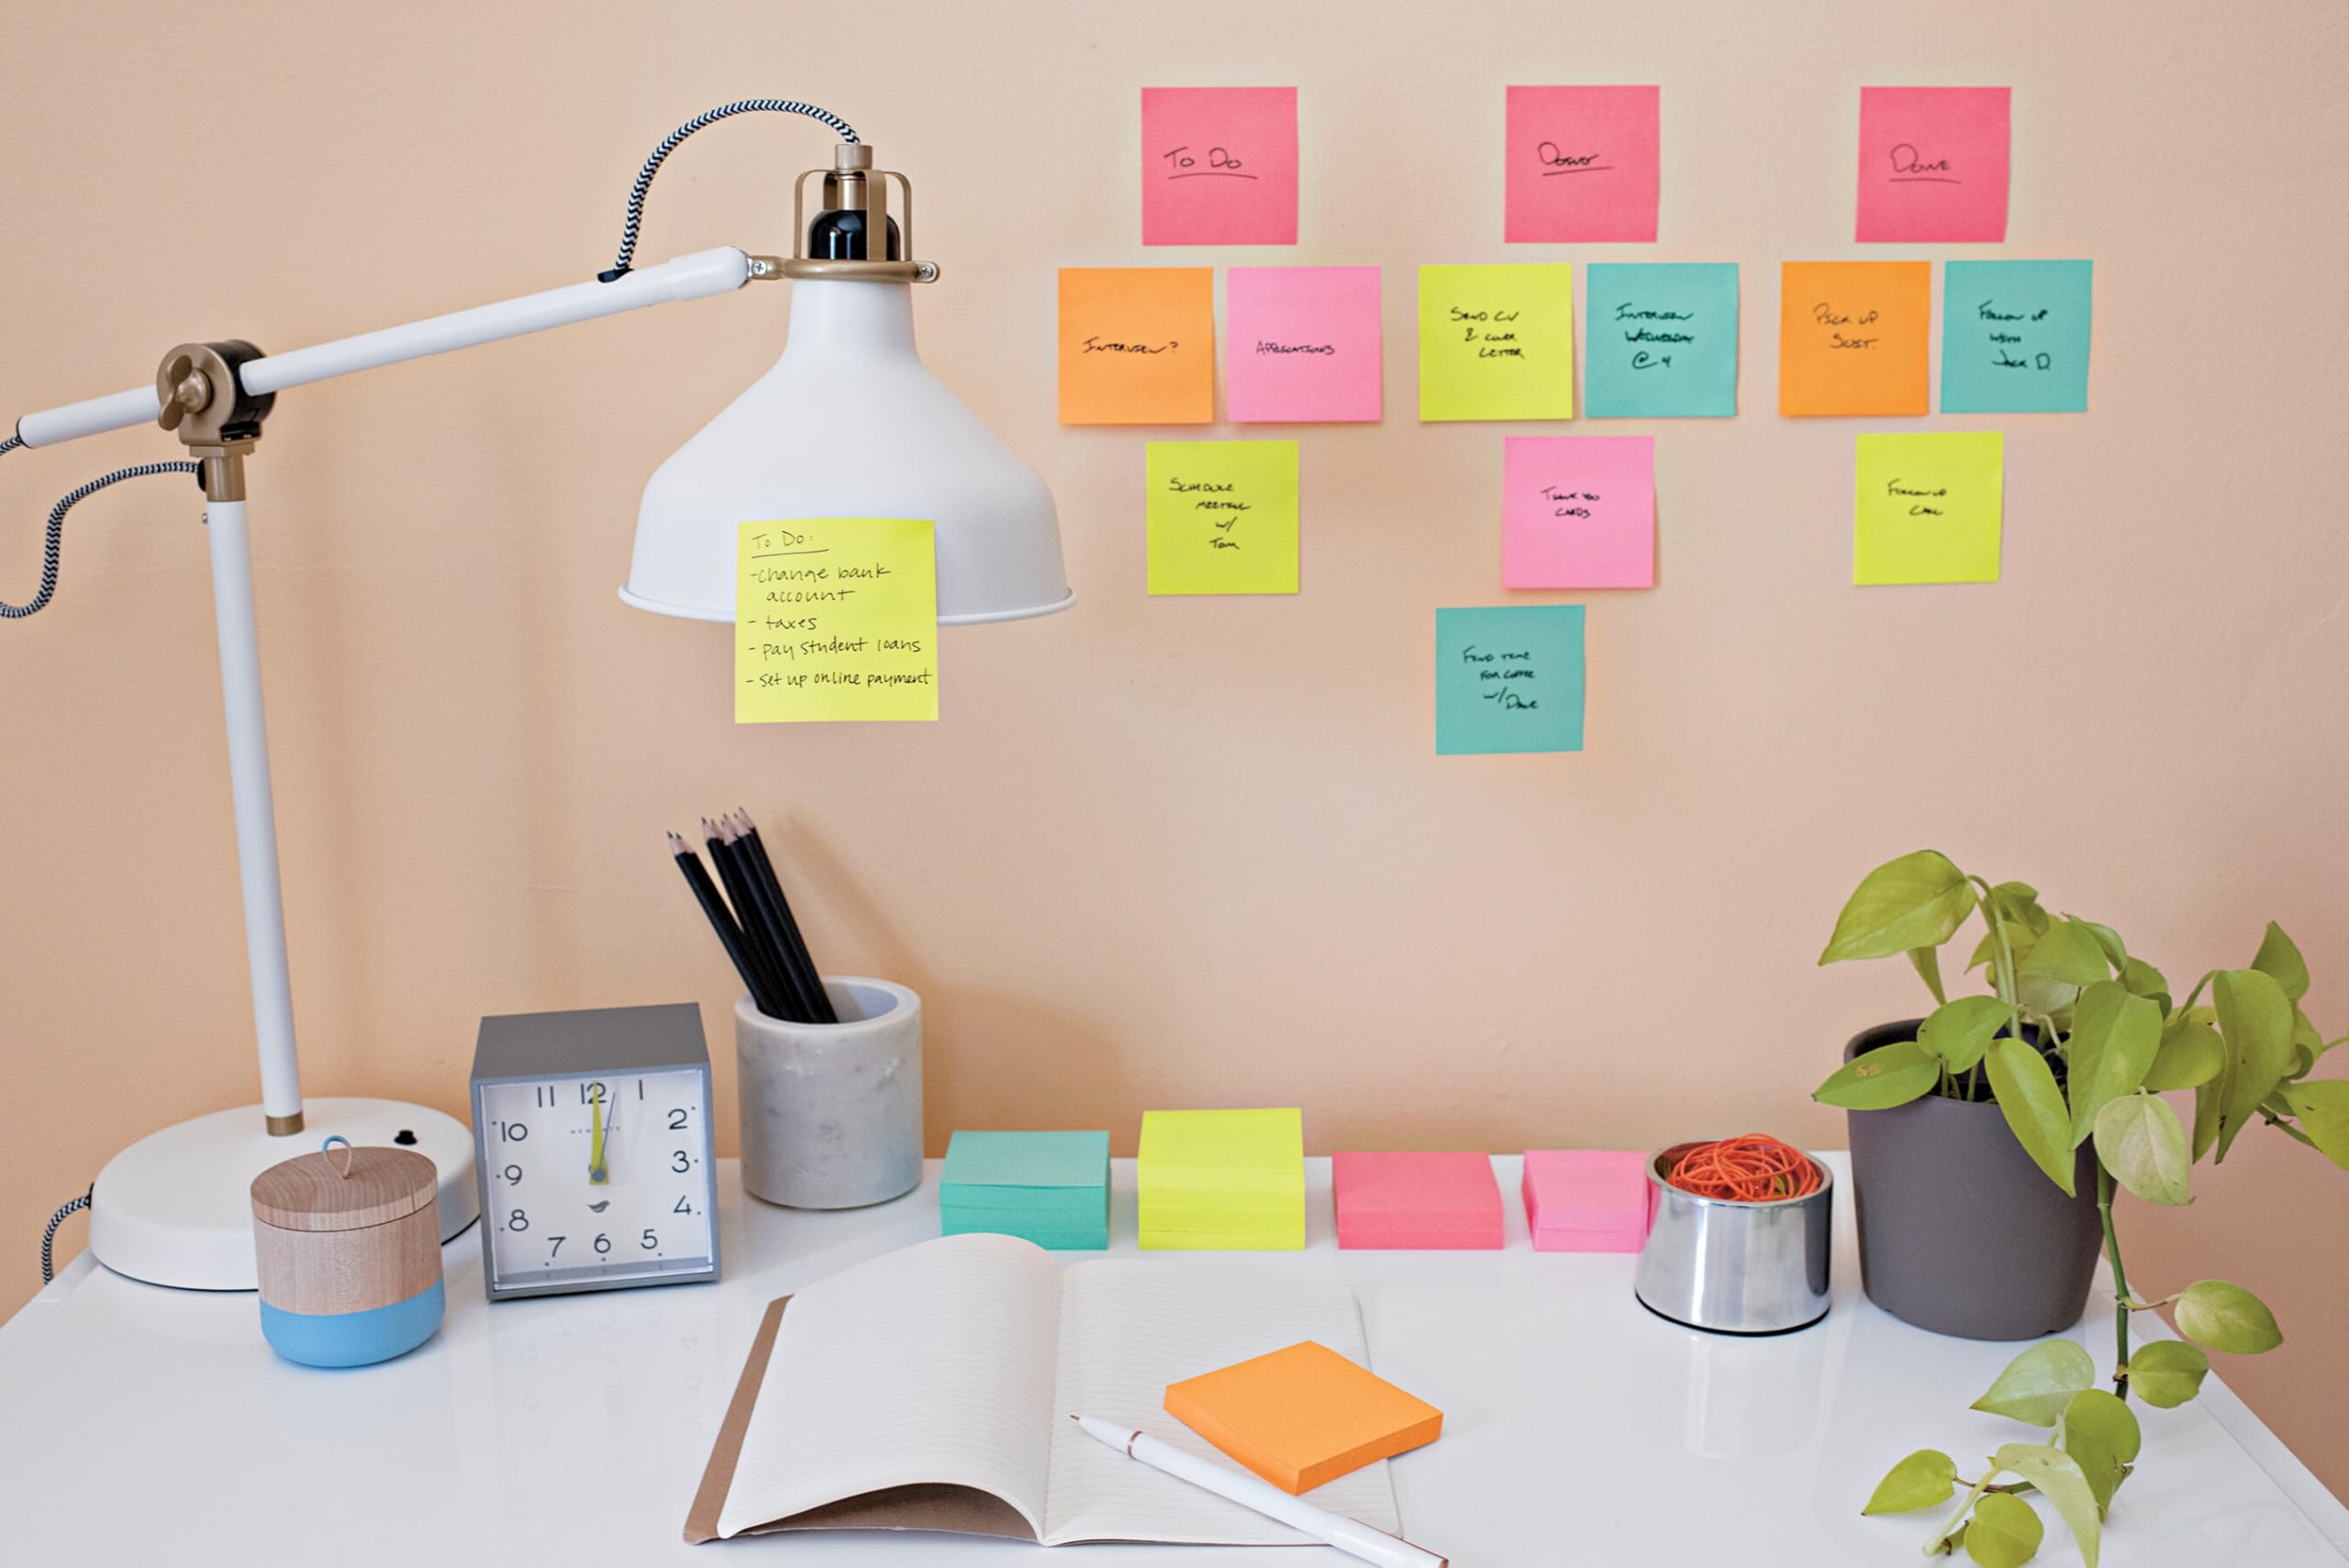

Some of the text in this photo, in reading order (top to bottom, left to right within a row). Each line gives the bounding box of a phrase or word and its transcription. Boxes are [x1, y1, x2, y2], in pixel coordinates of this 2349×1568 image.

[1662, 355, 1672, 368] 4
[838, 562, 893, 579] bank
[765, 589, 856, 604] account
[765, 614, 818, 631] taxes
[763, 641, 796, 662] pay
[799, 635, 870, 656] student
[876, 638, 922, 654] loans
[759, 672, 783, 688] set
[786, 673, 808, 690] up
[814, 670, 862, 686] online
[866, 667, 934, 689] payment
[537, 1085, 556, 1108] 11
[580, 1082, 607, 1106] 12
[638, 1079, 644, 1101] 1
[667, 1108, 688, 1130] 2
[501, 1121, 529, 1142] 10
[671, 1151, 690, 1173] 3
[504, 1164, 523, 1186] 9
[673, 1195, 693, 1216] 4
[507, 1208, 529, 1232] 8
[547, 1236, 567, 1258] 7
[593, 1233, 612, 1254] 6
[640, 1229, 659, 1251] 5
